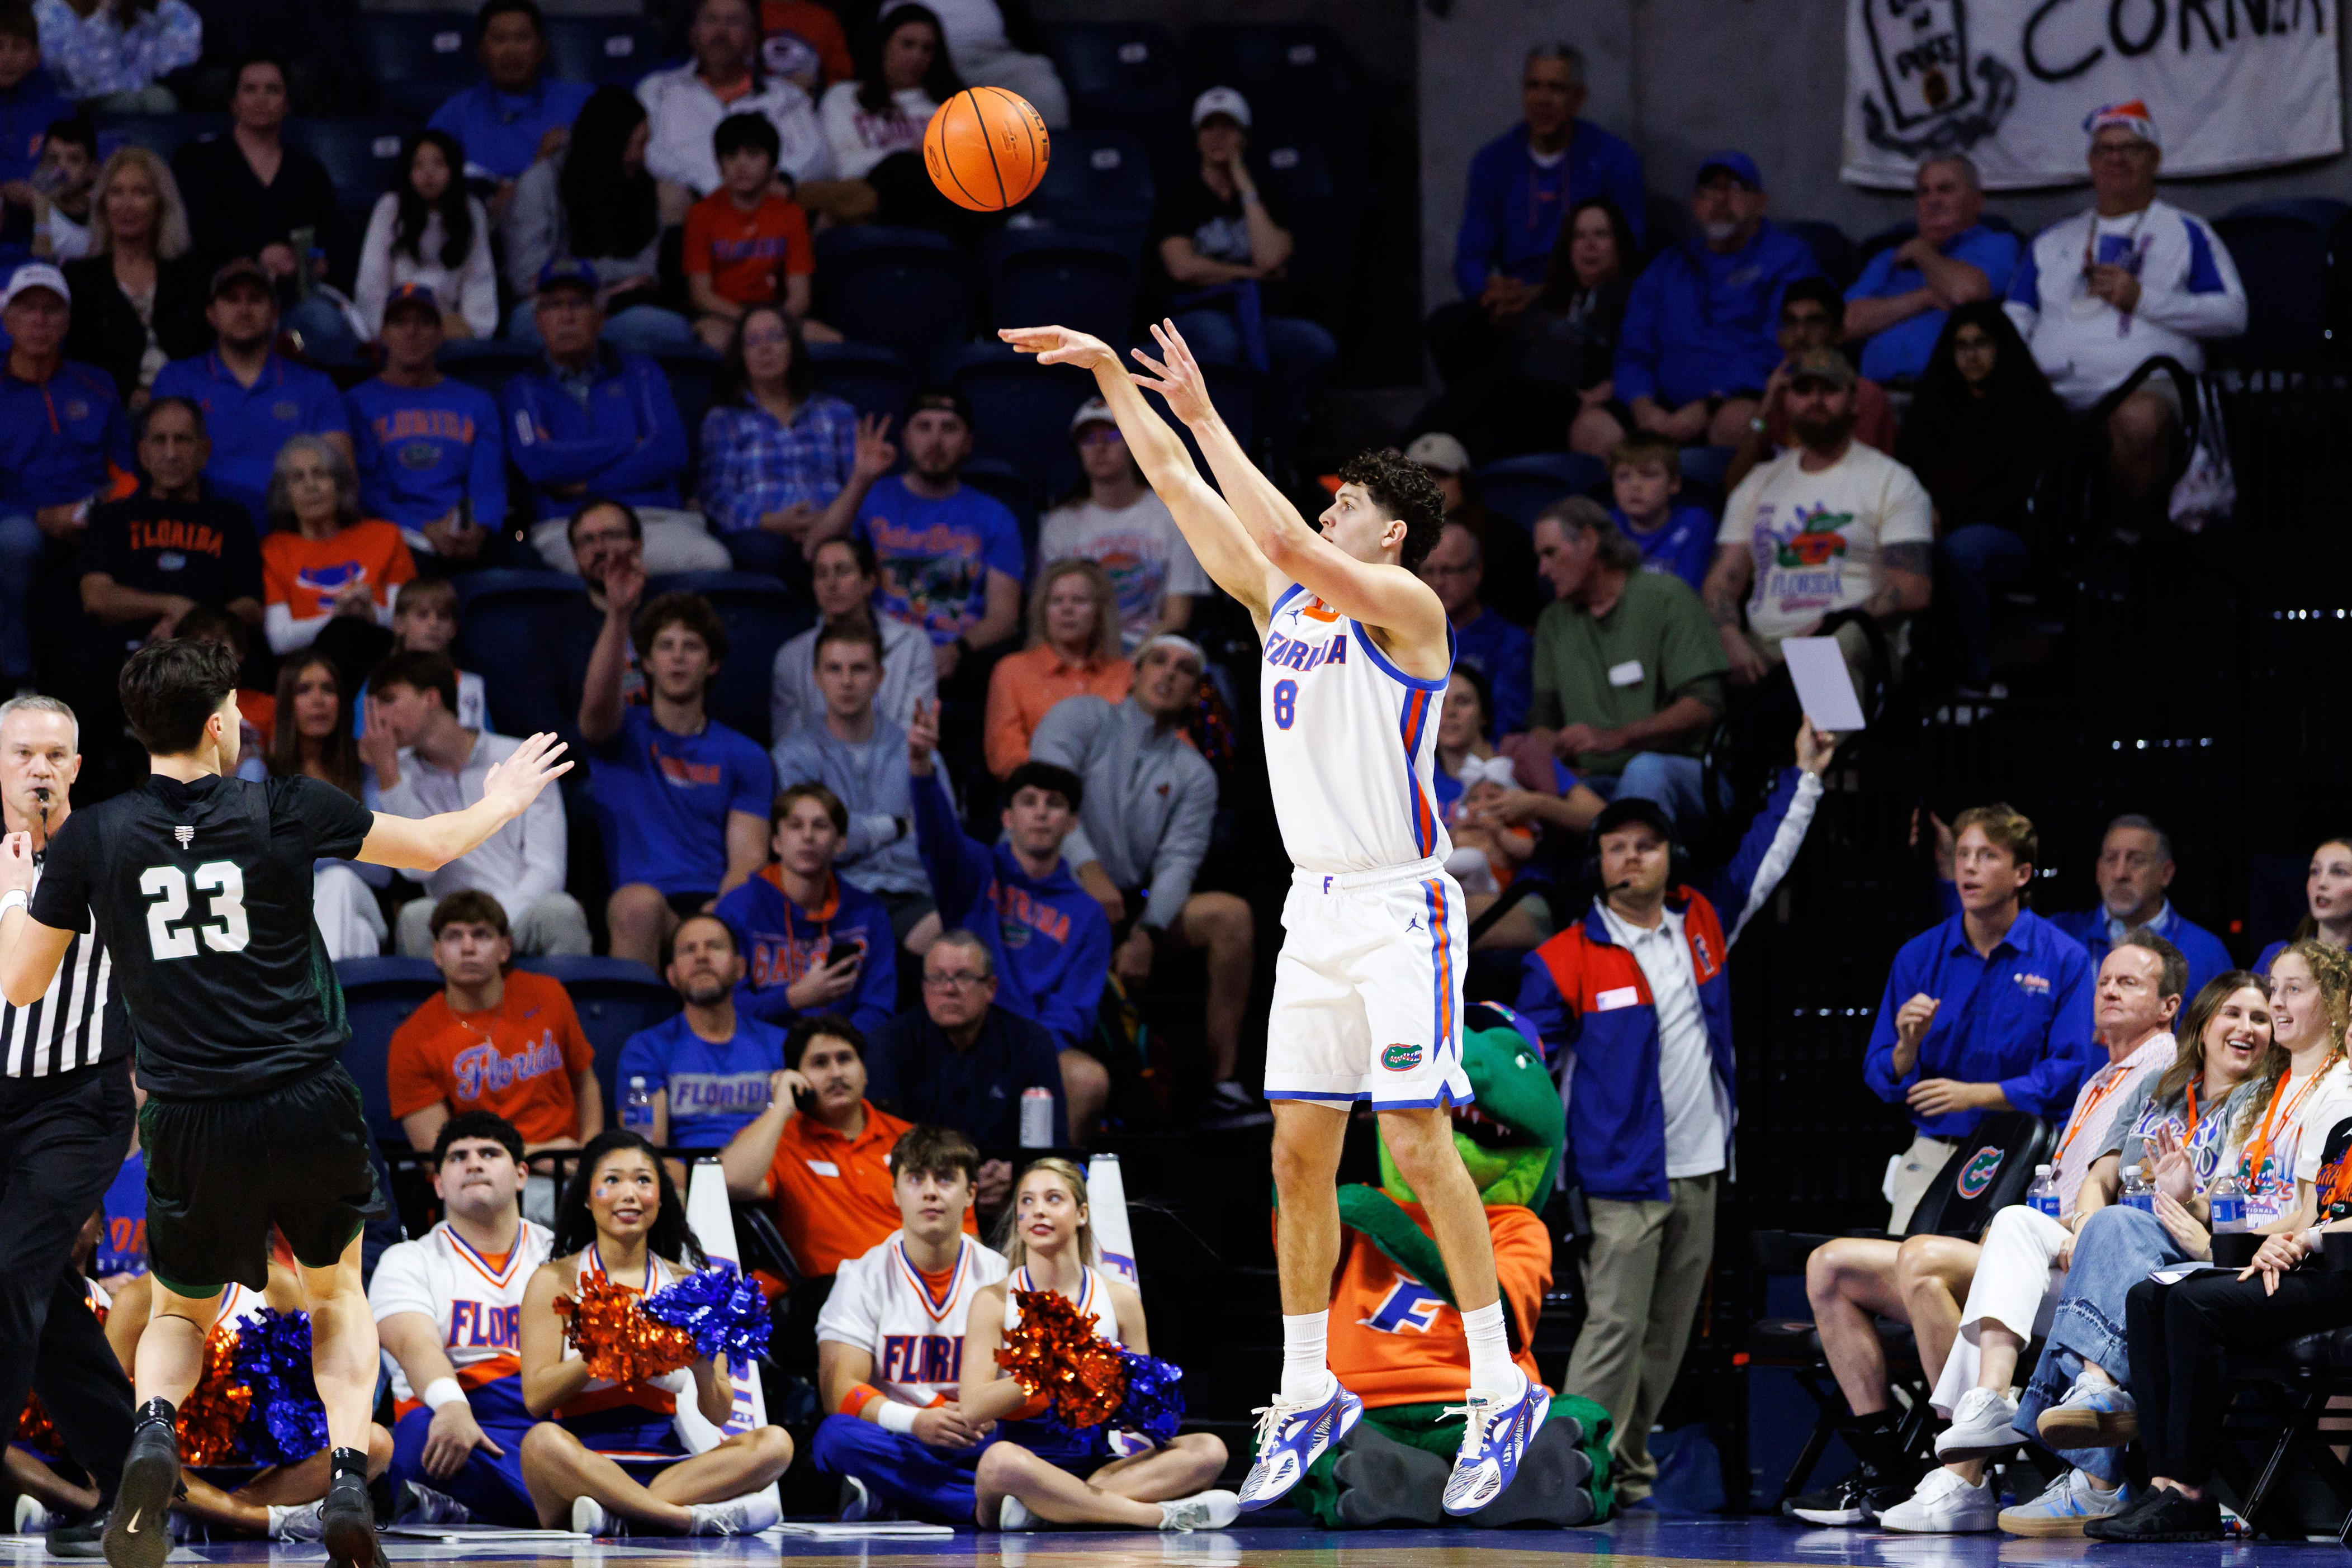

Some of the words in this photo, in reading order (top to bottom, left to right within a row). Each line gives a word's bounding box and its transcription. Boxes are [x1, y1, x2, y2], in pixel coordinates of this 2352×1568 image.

[129, 517, 224, 560] FLORIDA
[1273, 679, 1299, 730] 8
[1323, 876, 1333, 894] F
[139, 859, 252, 963] 23
[452, 1027, 564, 1102] Florida
[447, 1300, 520, 1351] FLOR
[883, 1335, 966, 1384] FLORI
